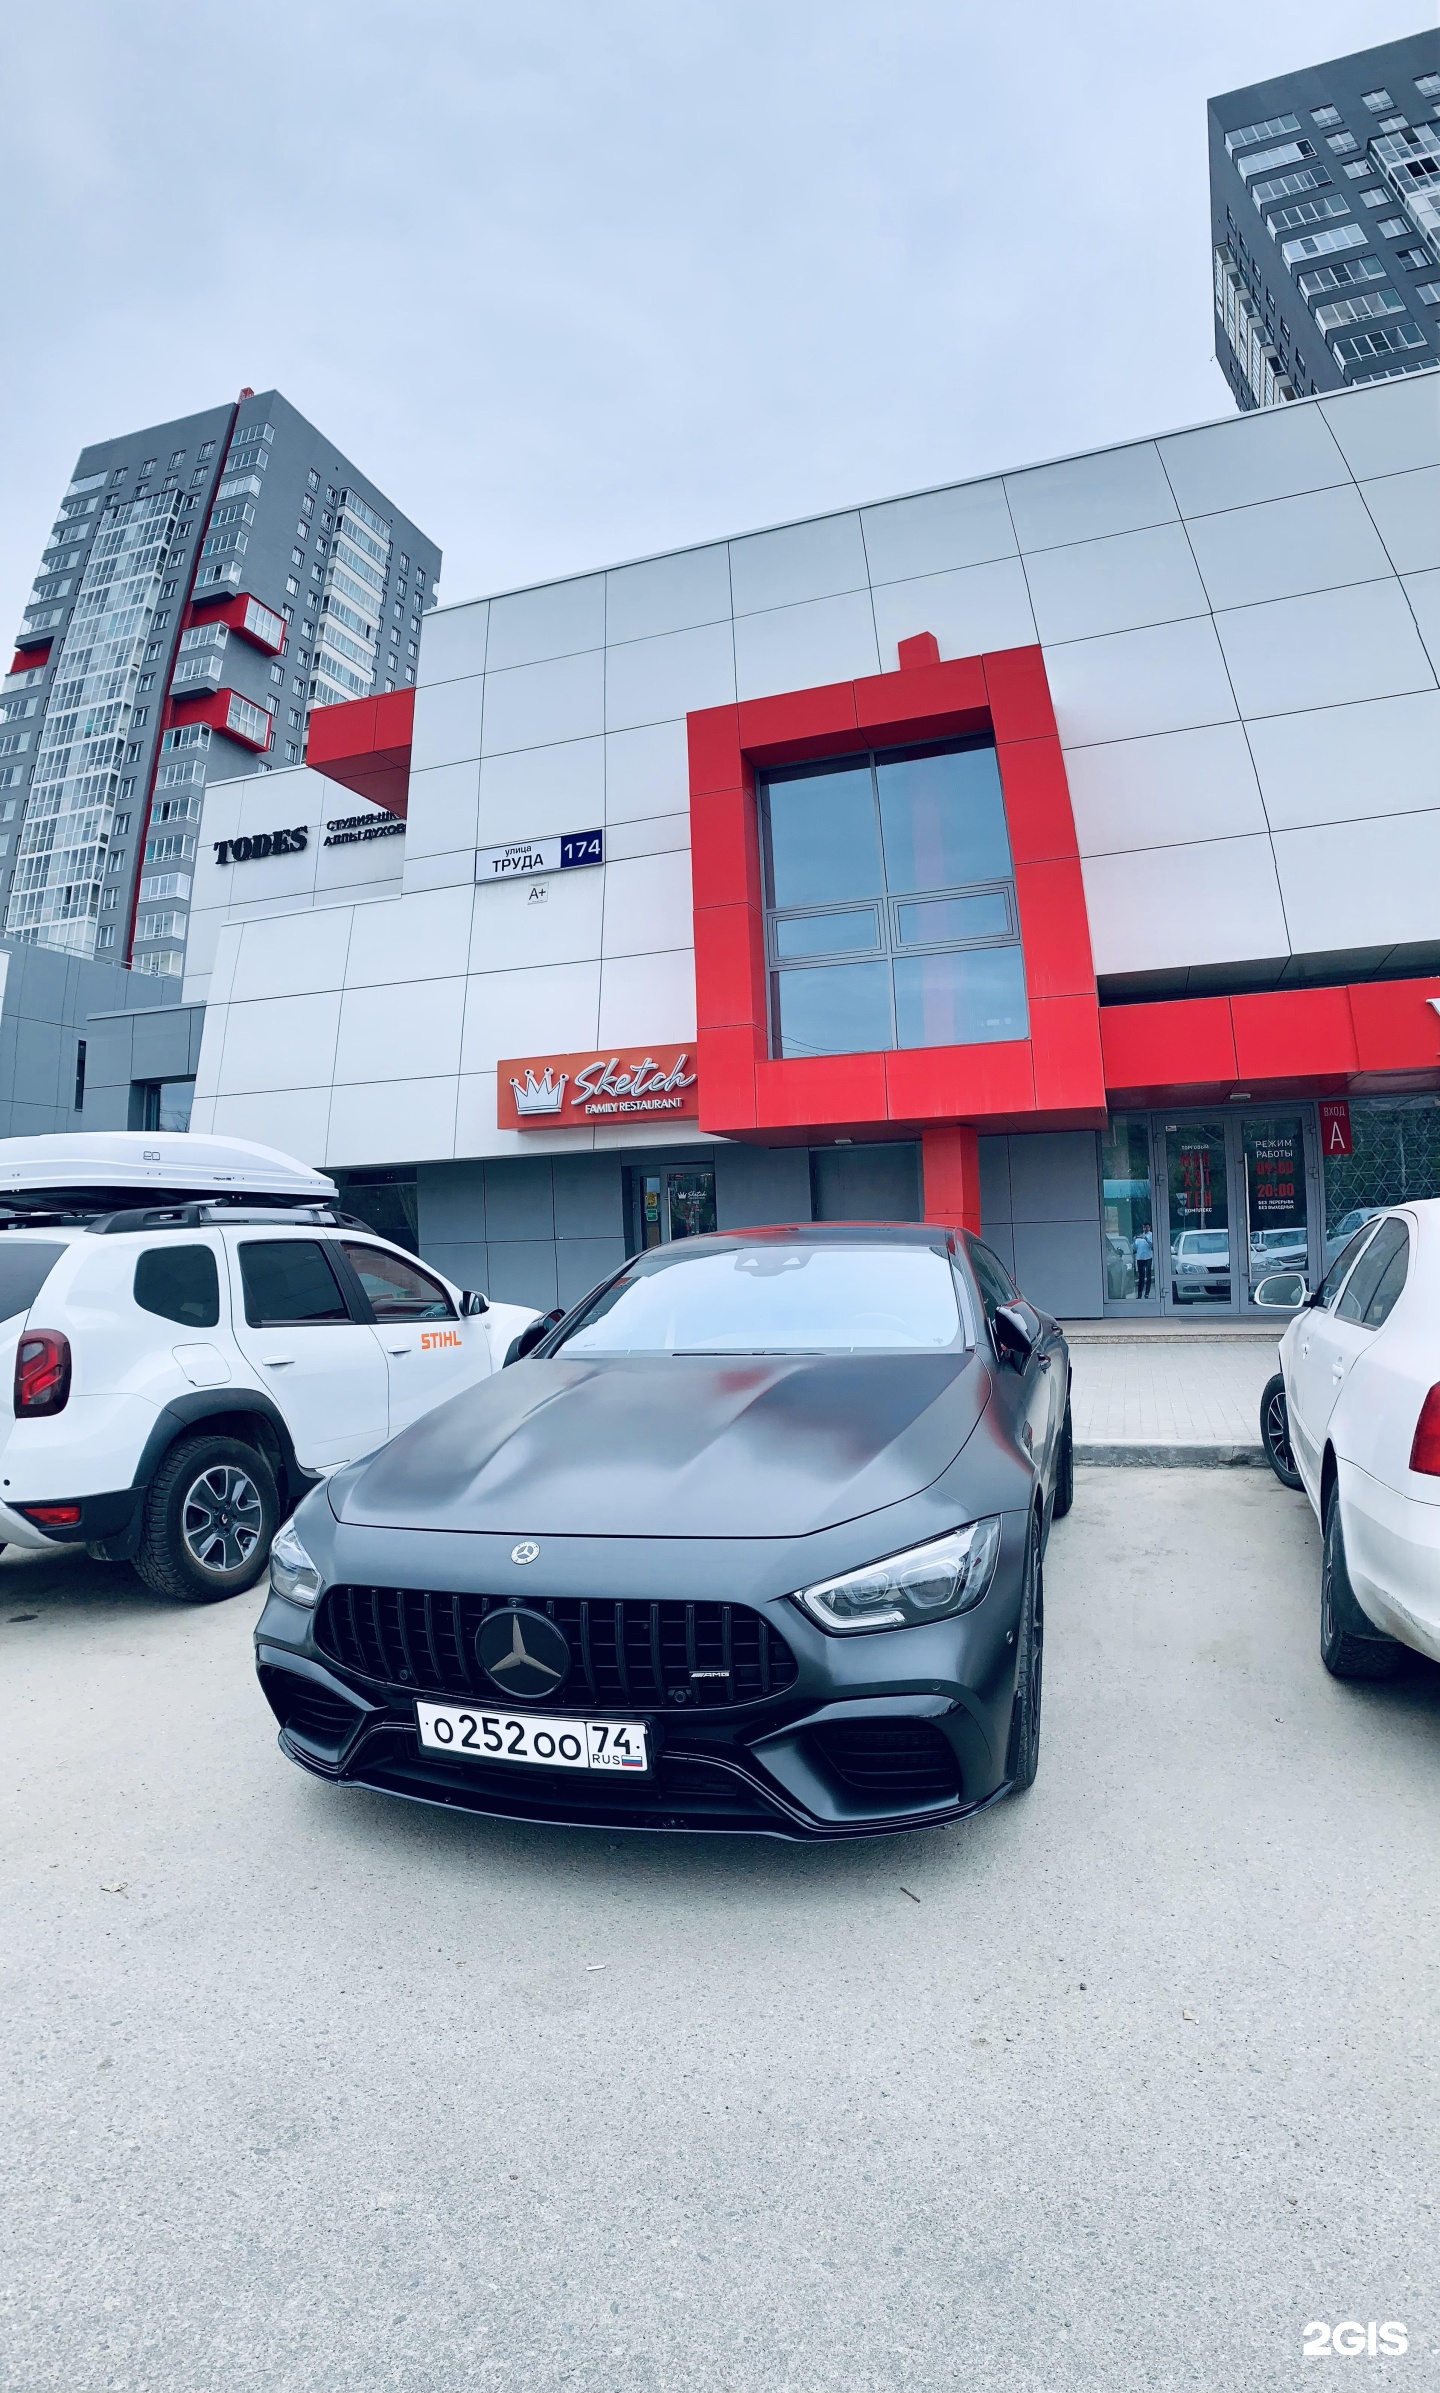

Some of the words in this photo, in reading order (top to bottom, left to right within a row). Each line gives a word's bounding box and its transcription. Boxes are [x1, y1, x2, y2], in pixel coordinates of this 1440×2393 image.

[323, 831, 361, 846] АЛЛЫ
[363, 823, 406, 841] ДУХОВ
[213, 825, 308, 864] TODES
[505, 845, 532, 857] улица
[564, 839, 600, 859] 174
[492, 853, 543, 873] ТРУДА
[571, 1054, 697, 1106] Sketch
[585, 1103, 619, 1114] FAMILY
[619, 1098, 684, 1112] RESTAURANT
[1323, 1106, 1346, 1117] ВХОД
[1255, 1139, 1293, 1148] РЕЖИМ
[1256, 1150, 1293, 1158] РАБОТЫ
[1256, 1161, 1294, 1175] 09:00
[1257, 1183, 1295, 1198] 20:00
[1185, 1191, 1212, 1208] ТЕН
[421, 1331, 462, 1350] STIHL
[592, 1726, 631, 1755] 74
[592, 1754, 620, 1765] RUS
